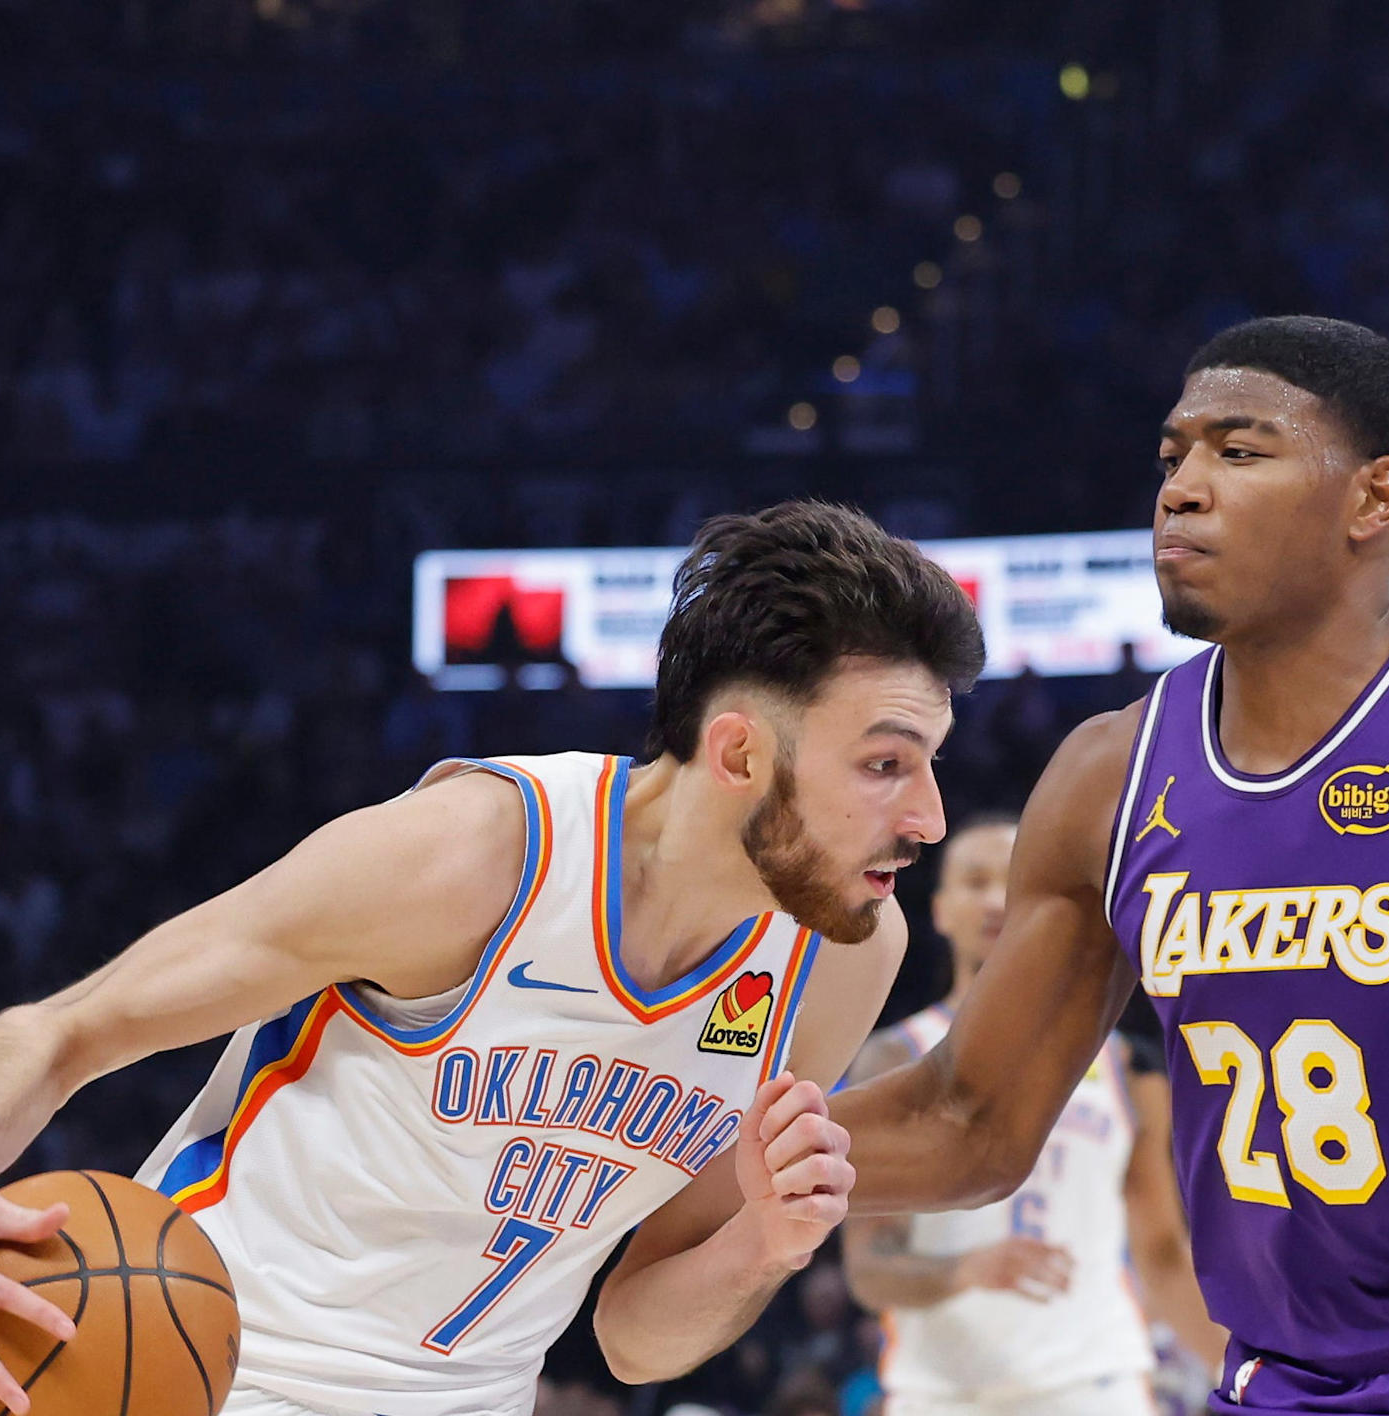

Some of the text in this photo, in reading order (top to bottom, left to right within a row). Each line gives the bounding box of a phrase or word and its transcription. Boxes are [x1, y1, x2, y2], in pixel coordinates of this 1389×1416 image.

[1340, 807, 1373, 819] 비비고
[431, 1045, 744, 1177] OKLAHOMA
[1179, 1018, 1387, 1210] 28
[484, 1136, 637, 1230] CITY
[420, 1216, 564, 1356] 7
